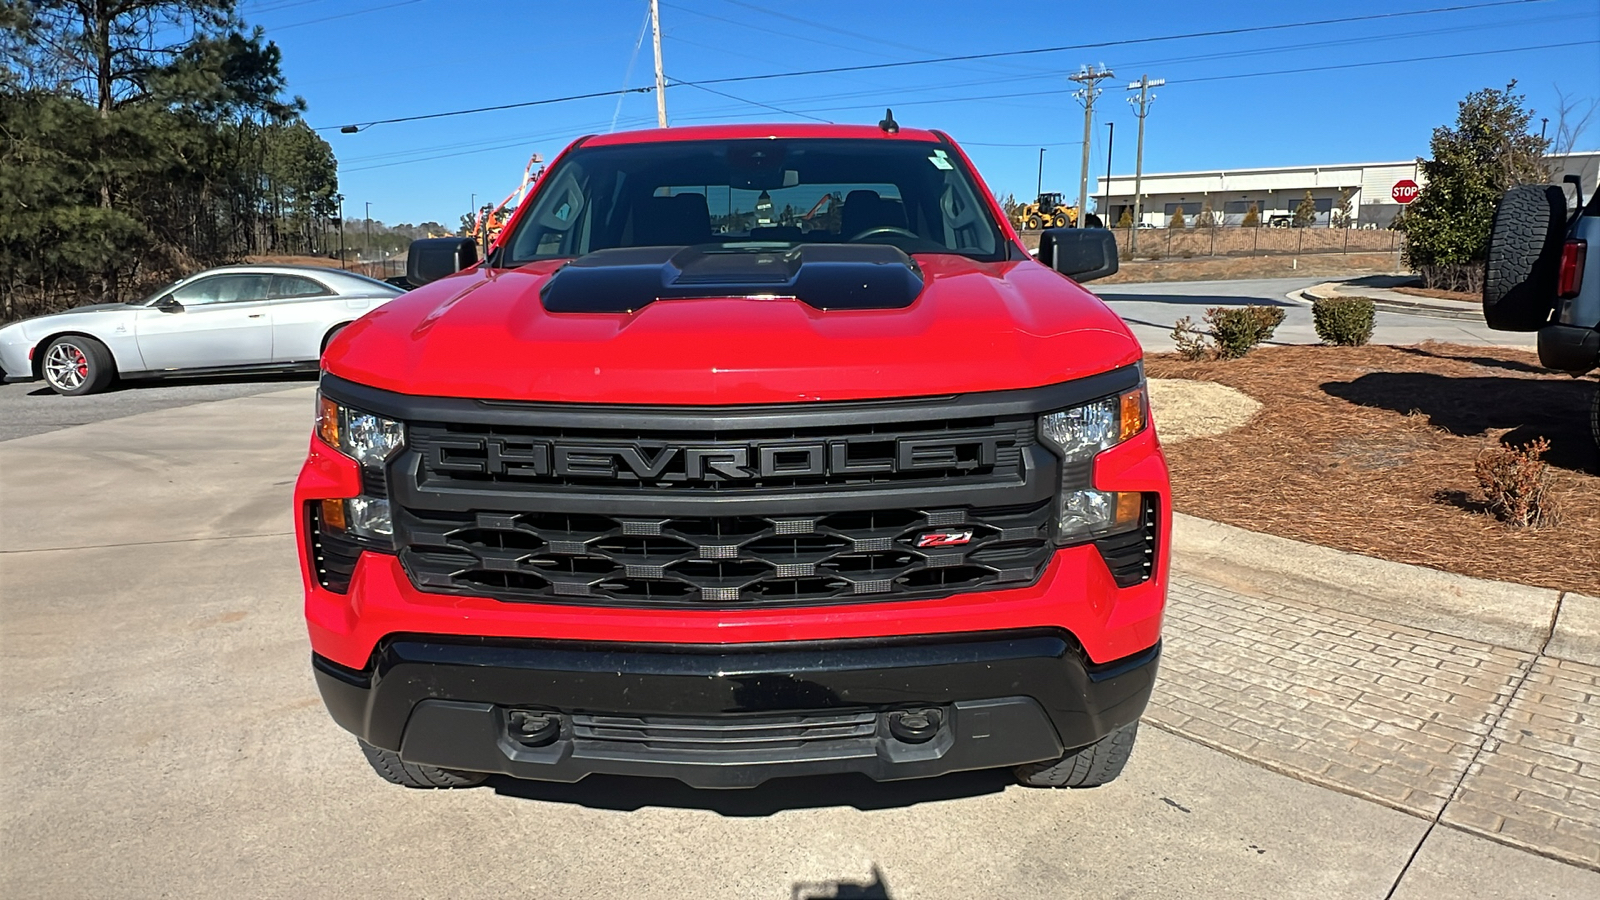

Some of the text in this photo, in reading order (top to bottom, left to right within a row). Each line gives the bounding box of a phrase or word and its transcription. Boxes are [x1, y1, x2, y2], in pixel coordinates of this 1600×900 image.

[1393, 187, 1418, 197] STOP
[428, 434, 1016, 480] CHEVROLET
[917, 531, 973, 547] Z71
